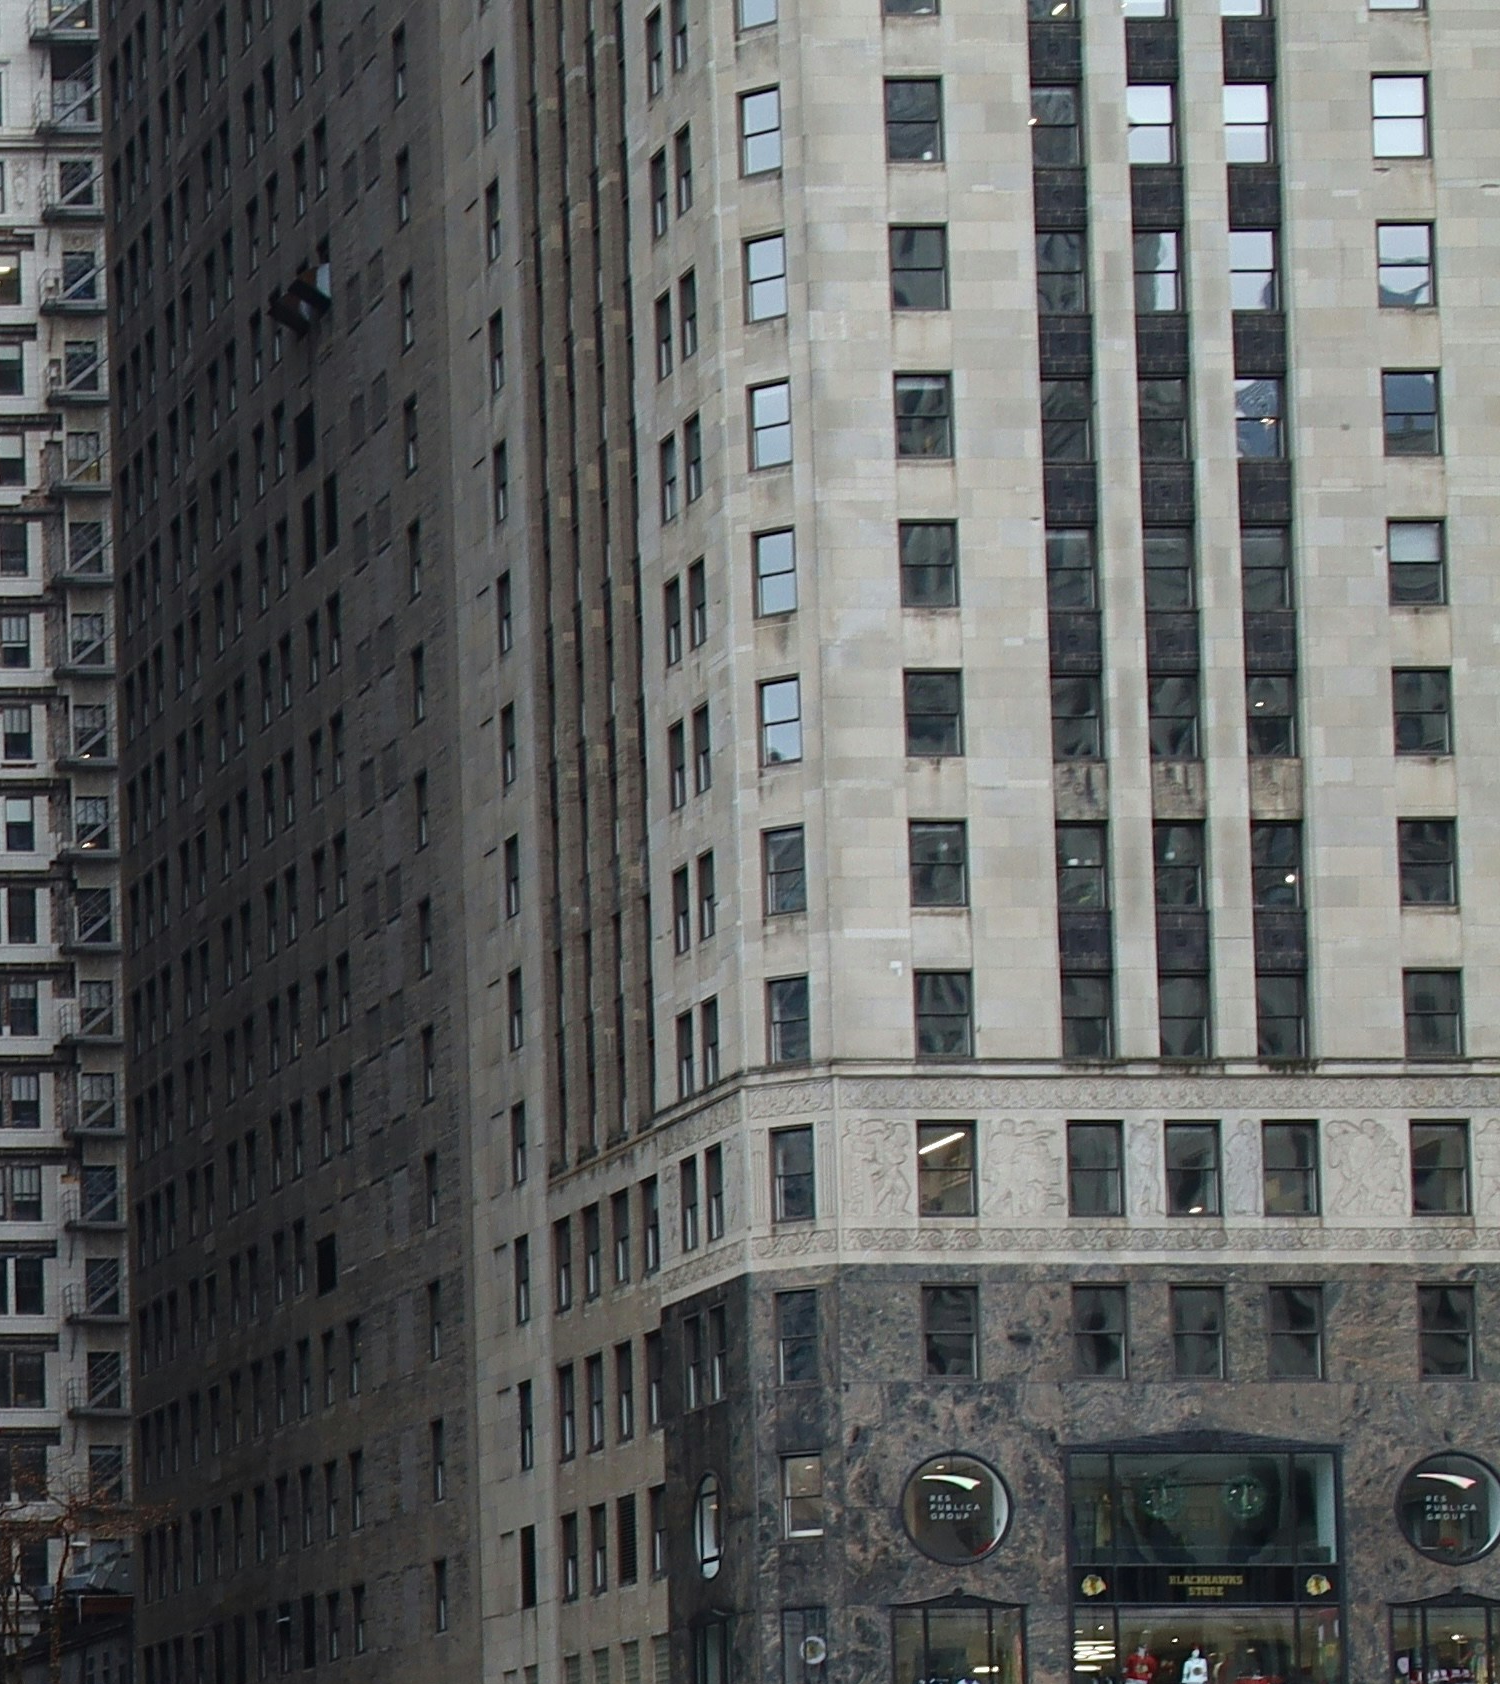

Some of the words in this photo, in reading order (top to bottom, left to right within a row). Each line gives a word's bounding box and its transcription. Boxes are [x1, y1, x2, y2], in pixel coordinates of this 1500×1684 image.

[929, 1503, 981, 1511] PUBLICA
[1425, 1503, 1477, 1511] PUBLICA
[930, 1512, 970, 1520] GROUP
[1426, 1512, 1467, 1520] GROUP
[1168, 1575, 1244, 1585] BLACKHAWKS
[1188, 1586, 1225, 1596] STORE
